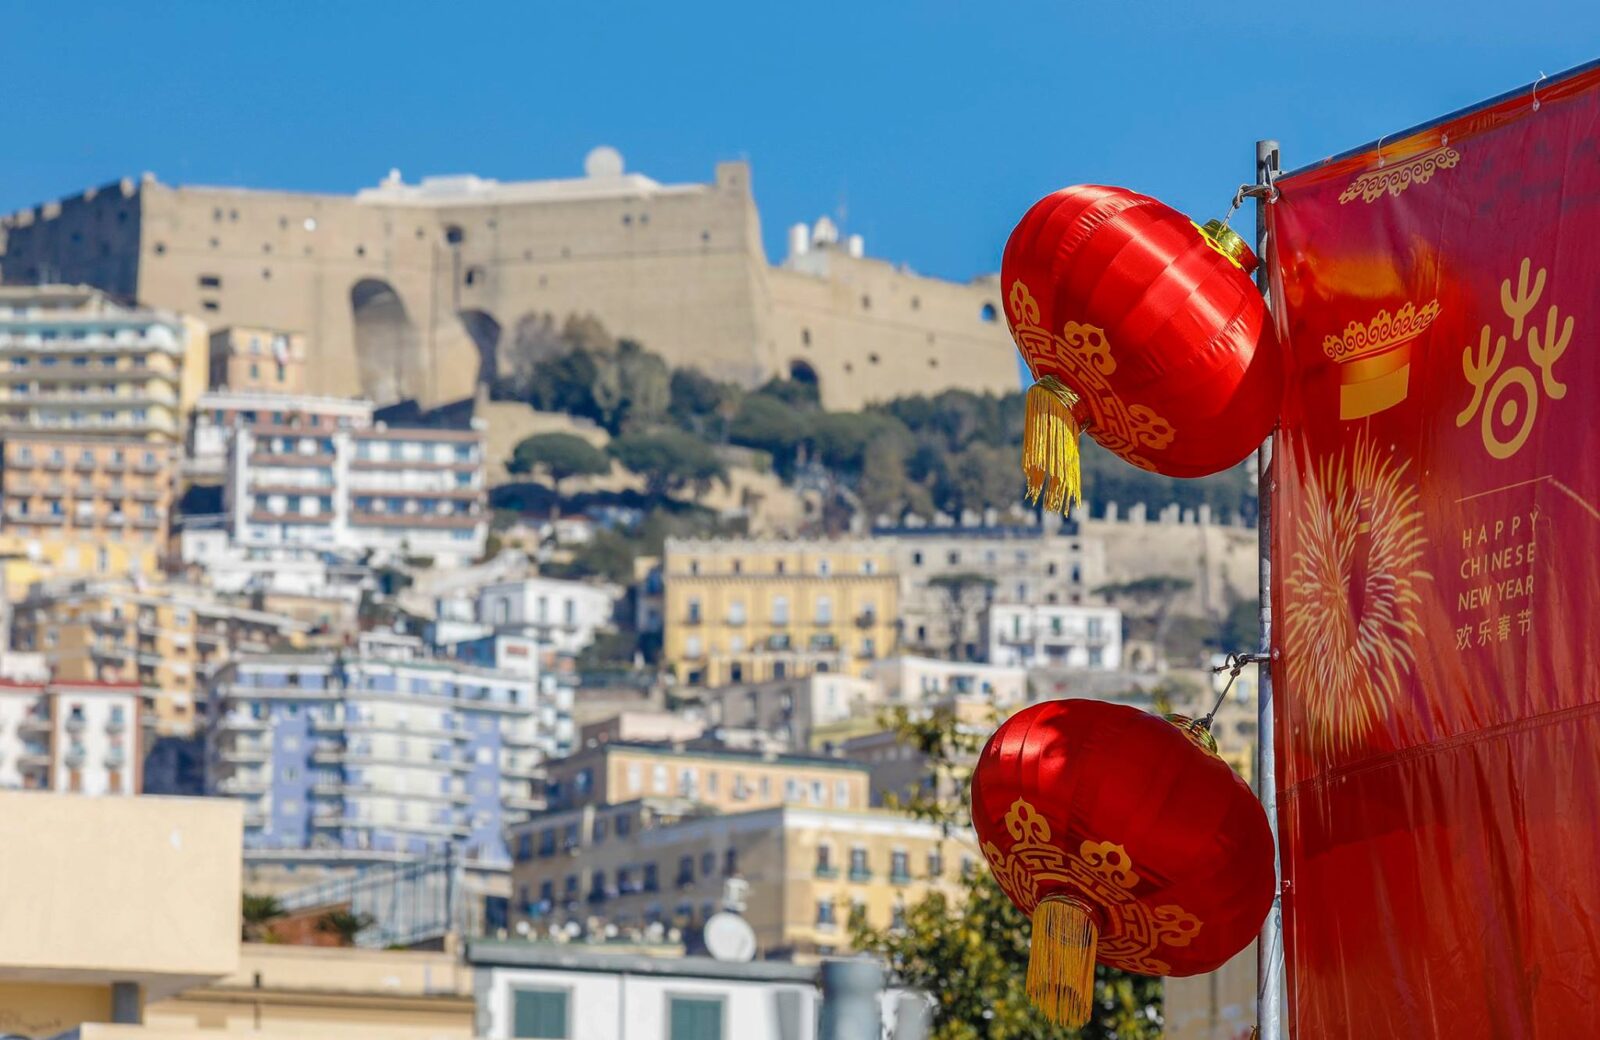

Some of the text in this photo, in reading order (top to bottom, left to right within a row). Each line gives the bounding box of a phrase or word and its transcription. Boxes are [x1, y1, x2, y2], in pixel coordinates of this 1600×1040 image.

[1462, 511, 1539, 549] HAPPY
[1460, 542, 1536, 580] CHINESE
[1458, 574, 1534, 612] NEW YEAR
[1455, 609, 1532, 651] 欢乐春节
